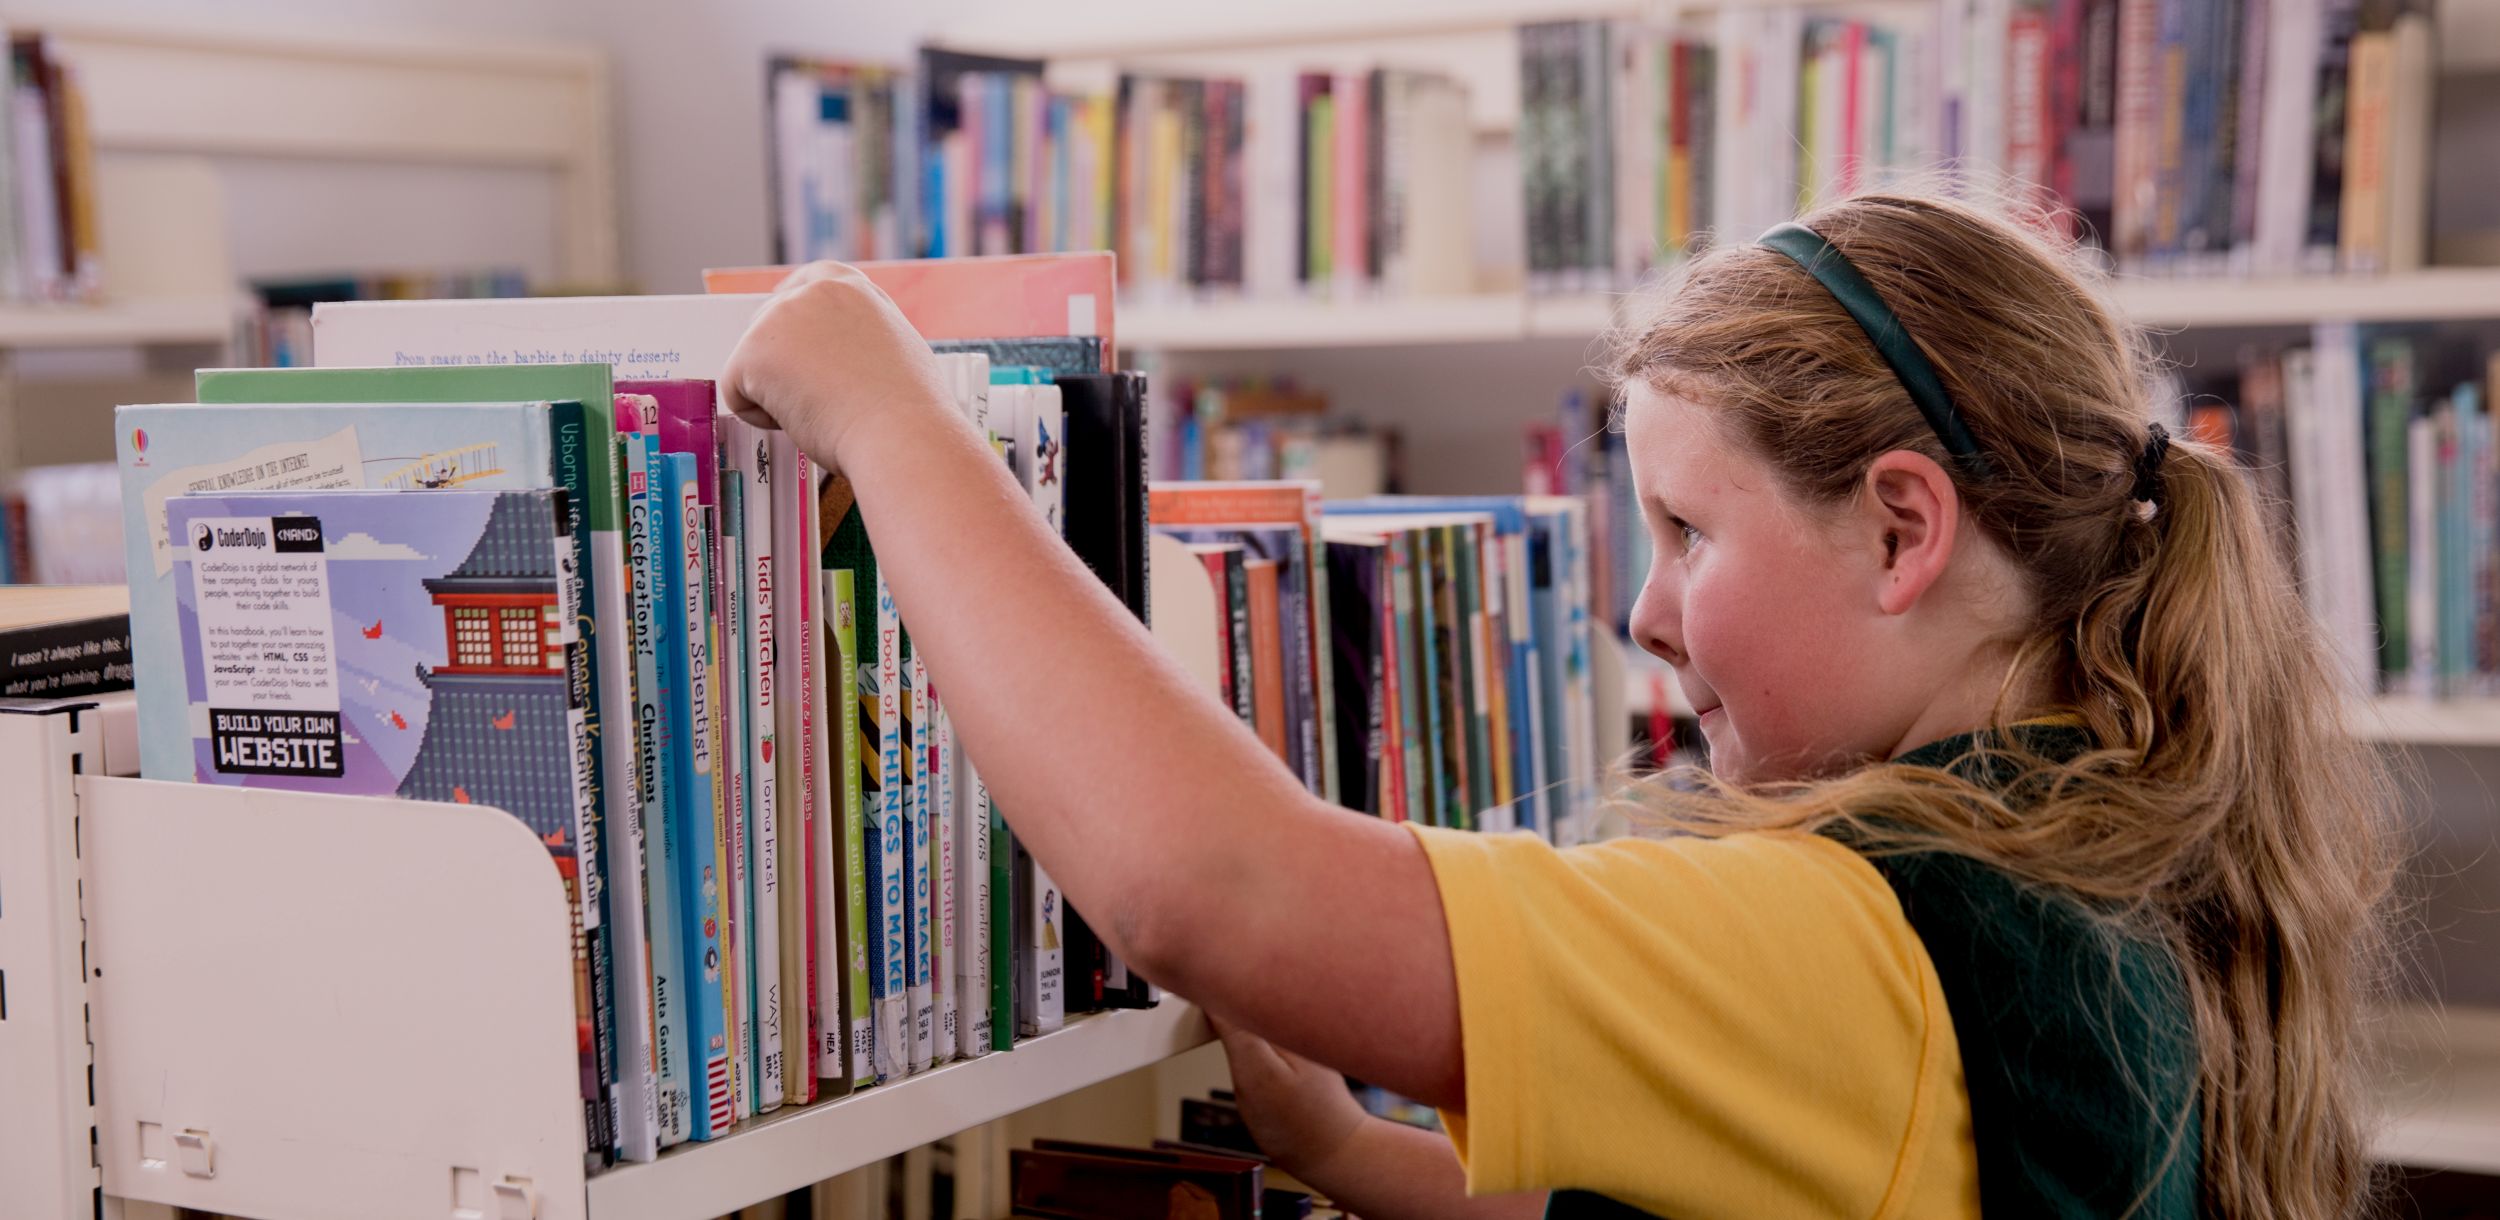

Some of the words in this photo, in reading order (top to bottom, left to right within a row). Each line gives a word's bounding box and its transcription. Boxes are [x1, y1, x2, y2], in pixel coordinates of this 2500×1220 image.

[395, 351, 425, 366] From
[466, 354, 481, 365] on
[487, 350, 508, 365] the
[515, 351, 557, 364] barbie
[562, 352, 575, 363] to
[580, 351, 622, 366] dainty
[627, 350, 680, 364] desserts
[643, 406, 657, 425] 12
[976, 393, 987, 428] The
[217, 468, 255, 490] KNOWLEDGE
[255, 465, 265, 480] ON
[265, 461, 279, 477] THE
[280, 453, 310, 474] INTERNET
[560, 423, 580, 490] Usborne
[649, 451, 663, 503] World
[217, 528, 267, 549] CoderDojo
[685, 495, 701, 570] LOOK
[201, 562, 239, 573] CoderDojo
[241, 563, 247, 571] is
[256, 562, 278, 574] global
[281, 562, 307, 571] network
[310, 561, 317, 571] of
[650, 510, 667, 603] Geography
[202, 575, 216, 585] free
[221, 576, 256, 587] computing
[261, 575, 278, 584] clubs
[283, 575, 292, 584] for
[297, 577, 318, 587] young
[204, 588, 231, 599] people,
[233, 588, 260, 600] working
[263, 588, 291, 600] together
[293, 588, 300, 597] to
[302, 587, 320, 598] build
[632, 505, 653, 656] Celebrations!
[689, 582, 700, 613] I'm
[758, 556, 772, 610] kids'
[236, 602, 250, 610] their
[253, 602, 270, 610] code
[273, 601, 290, 610] skills.
[209, 626, 215, 635] In
[217, 626, 229, 635] this
[230, 626, 267, 637] handbook,
[269, 627, 288, 638] you'll
[289, 627, 306, 636] learn
[309, 627, 323, 636] how
[690, 622, 697, 631] a
[11, 652, 17, 667] I
[50, 645, 82, 661] always
[83, 640, 101, 656] like
[210, 640, 217, 648] to
[219, 641, 230, 650] put
[231, 640, 259, 651] together
[261, 642, 276, 650] your
[295, 642, 325, 651] amazing
[212, 653, 241, 661] websites
[245, 653, 259, 661] with
[263, 652, 289, 662] HTML,
[293, 652, 308, 662] CSS
[312, 653, 326, 662] and
[758, 615, 774, 706] kitchen
[801, 621, 810, 673] RUTHIE
[883, 629, 896, 687] book
[213, 664, 256, 676] JavaScript
[267, 666, 280, 675] and
[284, 666, 298, 674] how
[302, 666, 309, 674] to
[312, 666, 327, 675] start
[214, 680, 230, 689] your
[250, 677, 288, 689] CoderDojo
[291, 678, 311, 688] Nano
[314, 679, 328, 688] with
[843, 654, 852, 683] 100
[5, 680, 29, 695] what
[252, 692, 267, 701] your
[269, 690, 292, 700] friends.
[691, 643, 709, 760] Scientist
[803, 678, 811, 704] MAY
[916, 689, 926, 715] of
[216, 714, 262, 732] BUILD
[263, 715, 302, 733] YOUR
[304, 717, 335, 734] OWN
[803, 710, 811, 719] &
[846, 692, 858, 751] things
[884, 694, 897, 720] of
[219, 736, 337, 770] WEBSITE
[575, 722, 591, 798] CREATE
[642, 703, 656, 804] Christmas
[803, 726, 812, 767] LEIGH
[625, 761, 635, 793] CHILD
[849, 759, 856, 777] to
[916, 722, 928, 848] THINGS
[942, 747, 953, 818] crafts
[733, 773, 742, 816] WEIRD
[764, 778, 775, 832] lorna
[804, 772, 812, 820] HOBBS
[850, 783, 862, 836] make
[884, 727, 901, 855] THINGS
[581, 805, 595, 853] WITH
[628, 796, 638, 837] LABOUR
[736, 821, 745, 881] INSECTS
[764, 837, 777, 893] brash
[852, 844, 864, 878] and
[854, 883, 864, 907] do
[887, 869, 900, 907] TO
[917, 861, 928, 898] TO
[943, 840, 955, 947] activities
[979, 884, 988, 938] Charlie
[889, 913, 903, 994] MAKE
[917, 906, 930, 985] MAKE
[1040, 967, 1061, 981] JUNIOR
[657, 976, 667, 1018] Anita
[769, 984, 778, 1041] WAYL
[659, 1025, 671, 1078] Ganeri
[827, 1033, 835, 1055] HEA
[765, 1055, 773, 1079] BRA
[659, 1103, 670, 1128] GAN
